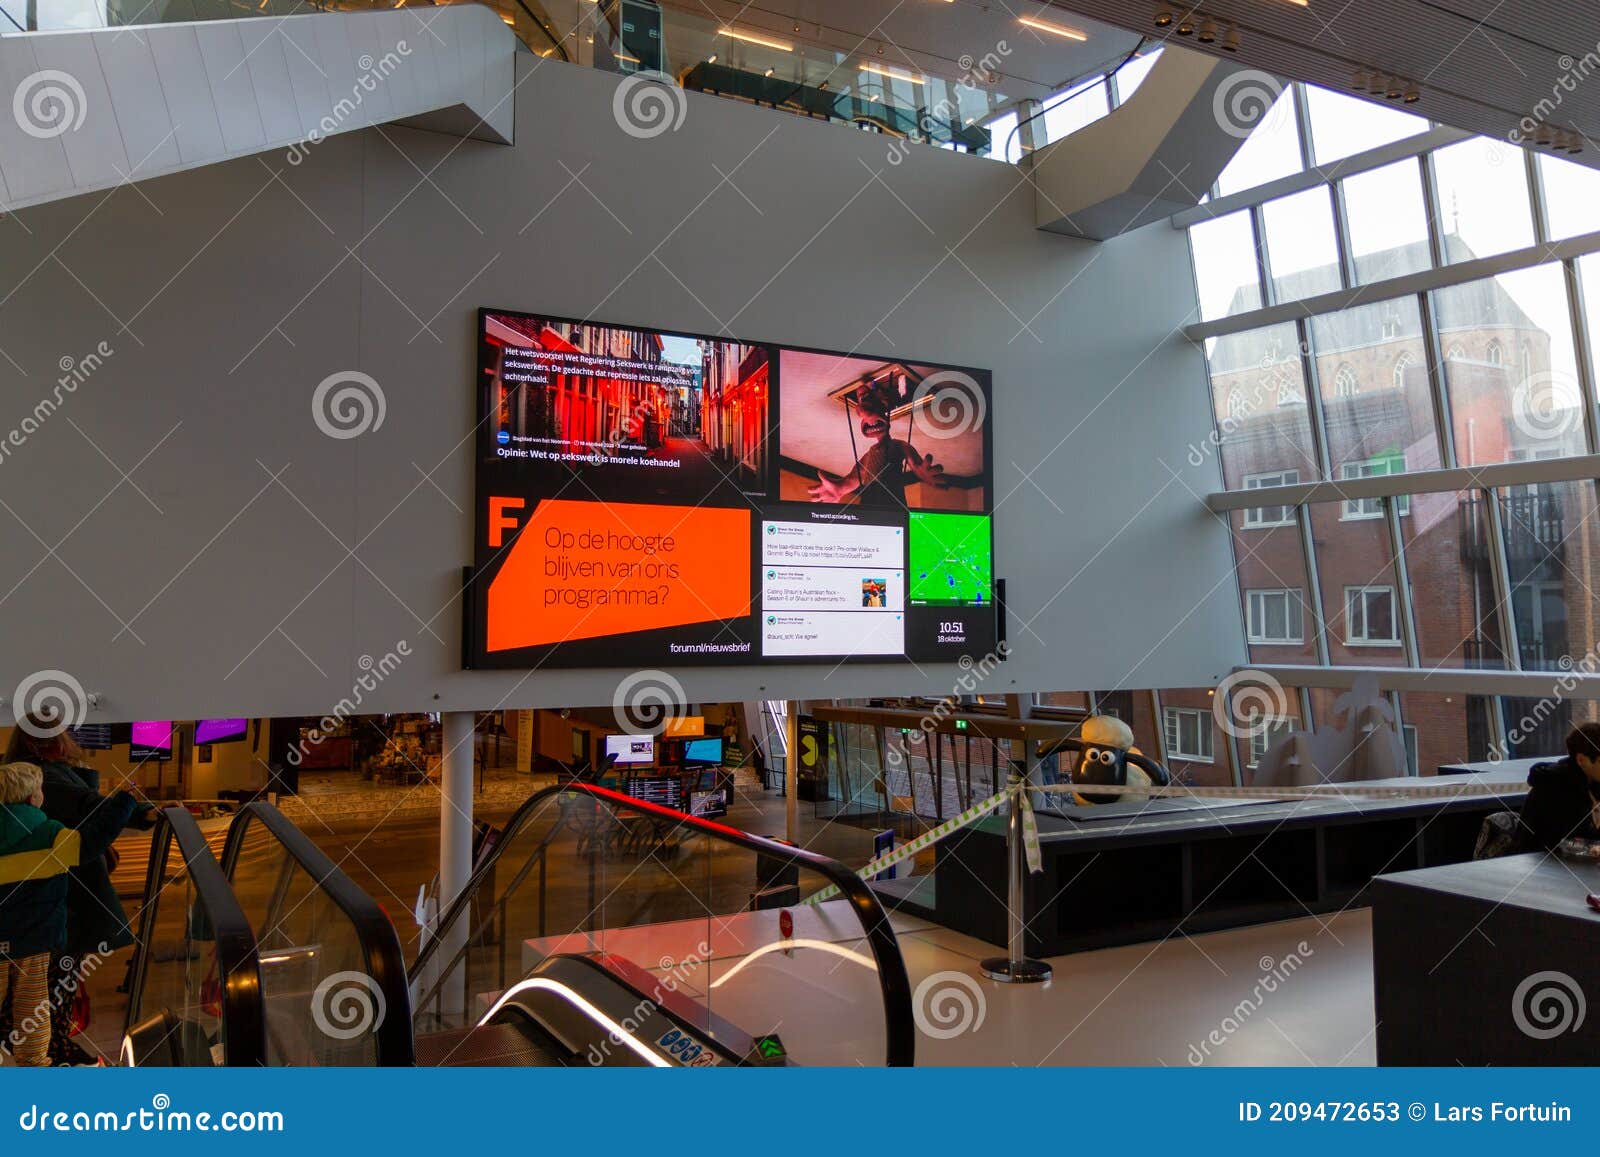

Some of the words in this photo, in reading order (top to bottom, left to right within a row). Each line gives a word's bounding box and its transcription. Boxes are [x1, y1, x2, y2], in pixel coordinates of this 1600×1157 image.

[505, 347, 521, 356] Het
[520, 350, 564, 361] wetsvoorstel
[565, 354, 579, 362] Wet
[580, 355, 615, 367] Regulering
[616, 359, 648, 369] Sekswerk
[552, 364, 562, 373] De
[563, 366, 595, 376] gedachte
[595, 369, 606, 377] dat
[607, 371, 638, 380] repressie
[639, 373, 650, 381] iets
[497, 447, 529, 458] Opinie:
[530, 449, 548, 459] Wet
[548, 452, 560, 461] op
[561, 452, 600, 463] sekswerk
[601, 455, 608, 463] is
[610, 456, 638, 465] morele
[640, 457, 680, 468] koehandel
[488, 496, 525, 547] F
[544, 527, 575, 556] Op
[578, 528, 604, 550] de
[607, 529, 675, 556] hoogte
[544, 556, 604, 581] blijven
[607, 562, 642, 578] van
[645, 562, 680, 579] ons
[544, 584, 670, 609] programma?
[939, 622, 964, 633] 10.51
[670, 642, 751, 653] forum.nl/nieuwsbrief
